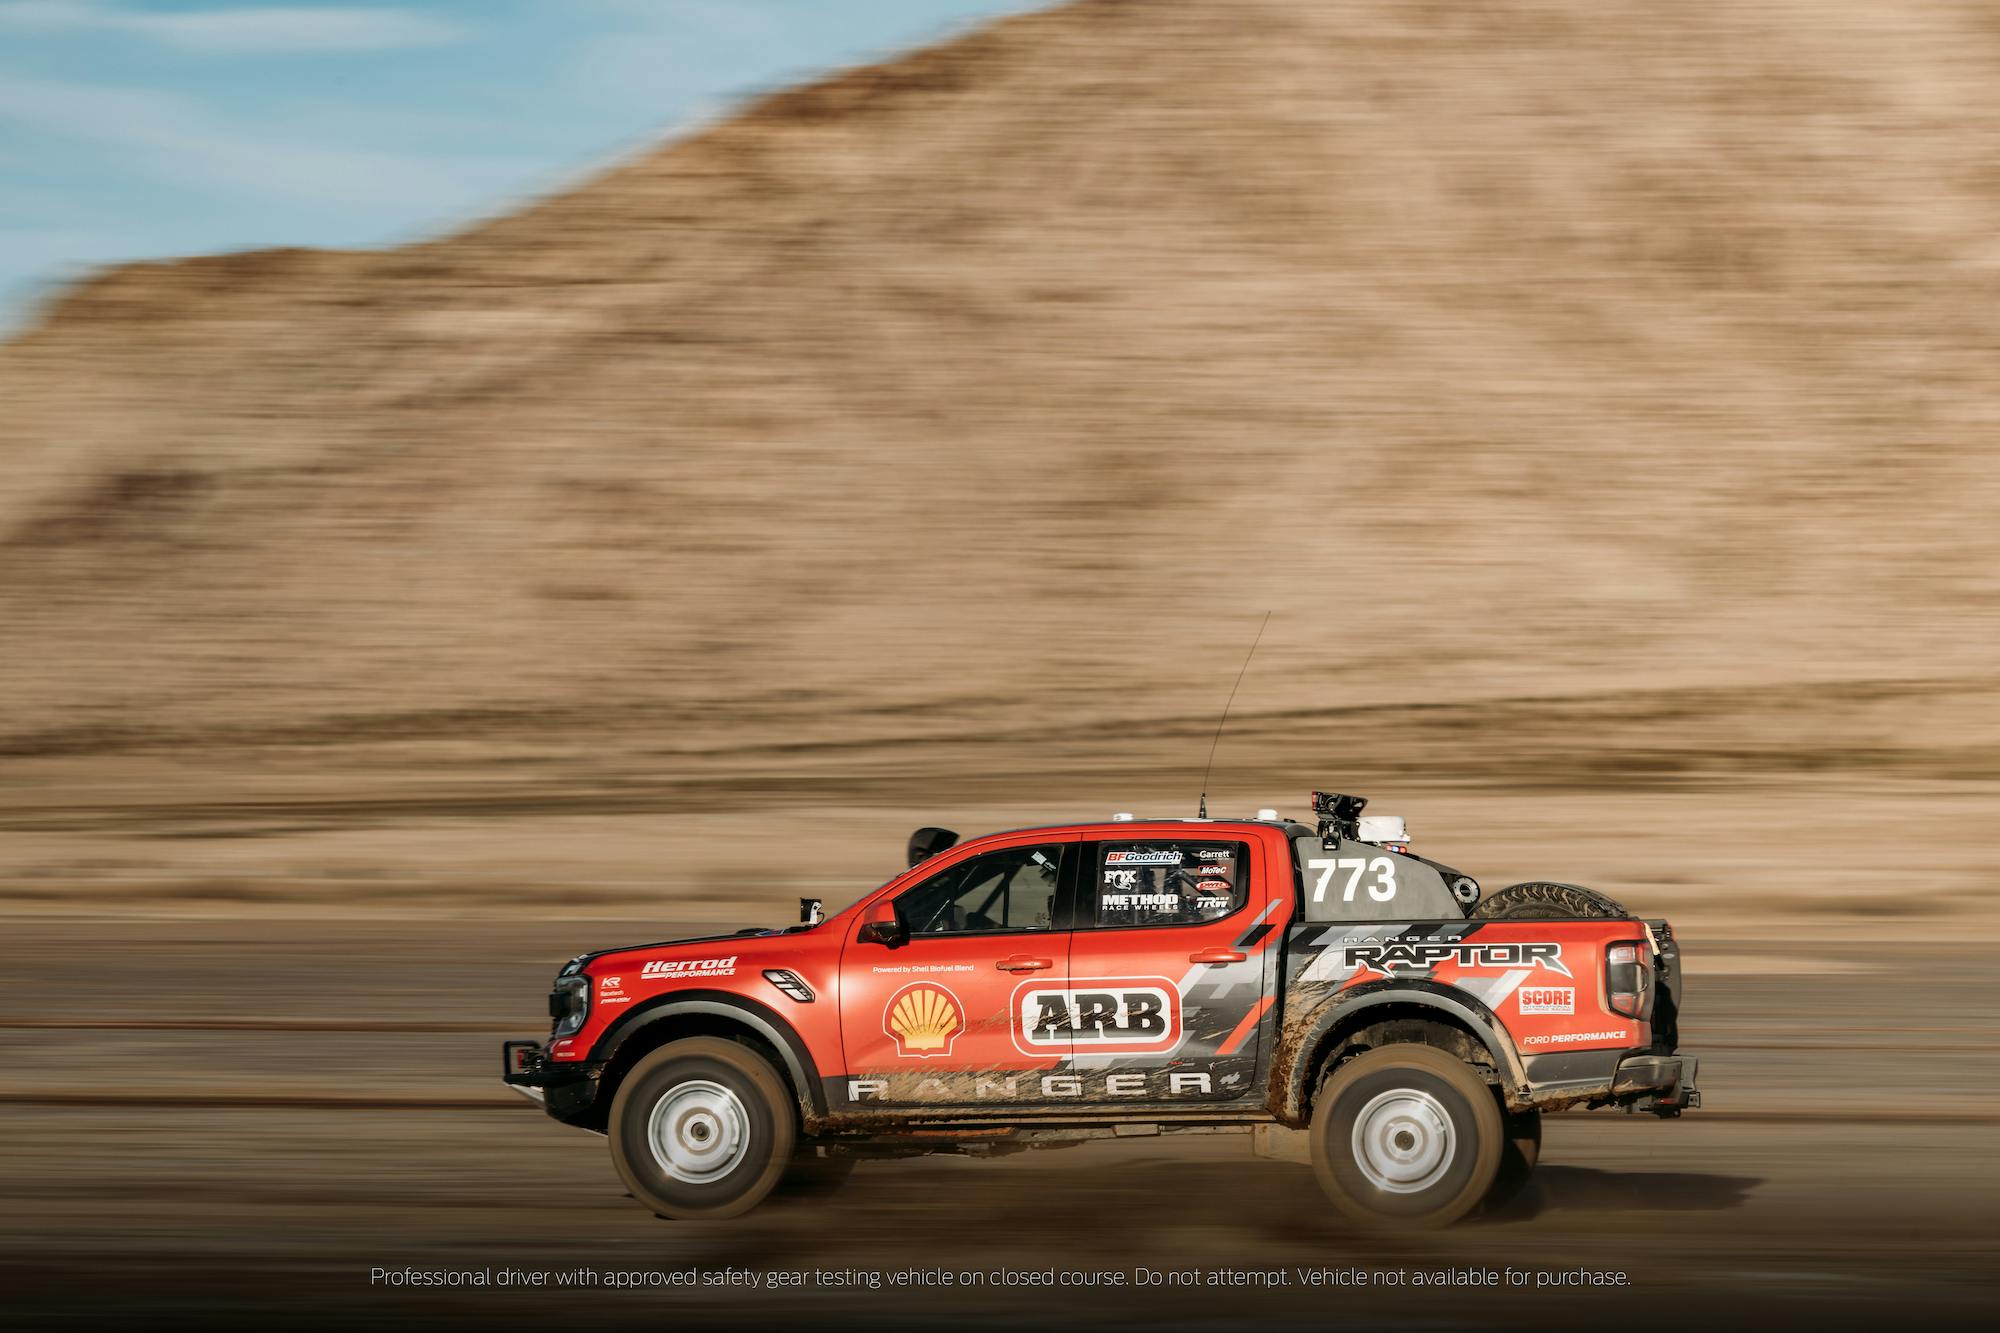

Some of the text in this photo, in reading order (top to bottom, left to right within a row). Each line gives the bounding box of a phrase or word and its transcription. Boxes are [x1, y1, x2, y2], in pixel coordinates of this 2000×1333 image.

[1107, 851, 1181, 861] BFGoodrich
[1200, 850, 1230, 858] Garrett
[1104, 870, 1137, 890] FOX
[1308, 856, 1397, 903] 773
[1102, 893, 1179, 905] METHOD
[1196, 896, 1229, 908] TRW
[1343, 935, 1462, 943] RANGER
[641, 956, 738, 973] Herrod
[1343, 942, 1574, 978] RAPTOR
[665, 968, 736, 979] PERFORMANCE
[911, 965, 929, 973] Shell
[601, 976, 621, 986] KR
[1522, 990, 1572, 1006] SCORE
[1031, 993, 1166, 1040] ARB
[1524, 1031, 1627, 1045] FORD PERFORMANCE
